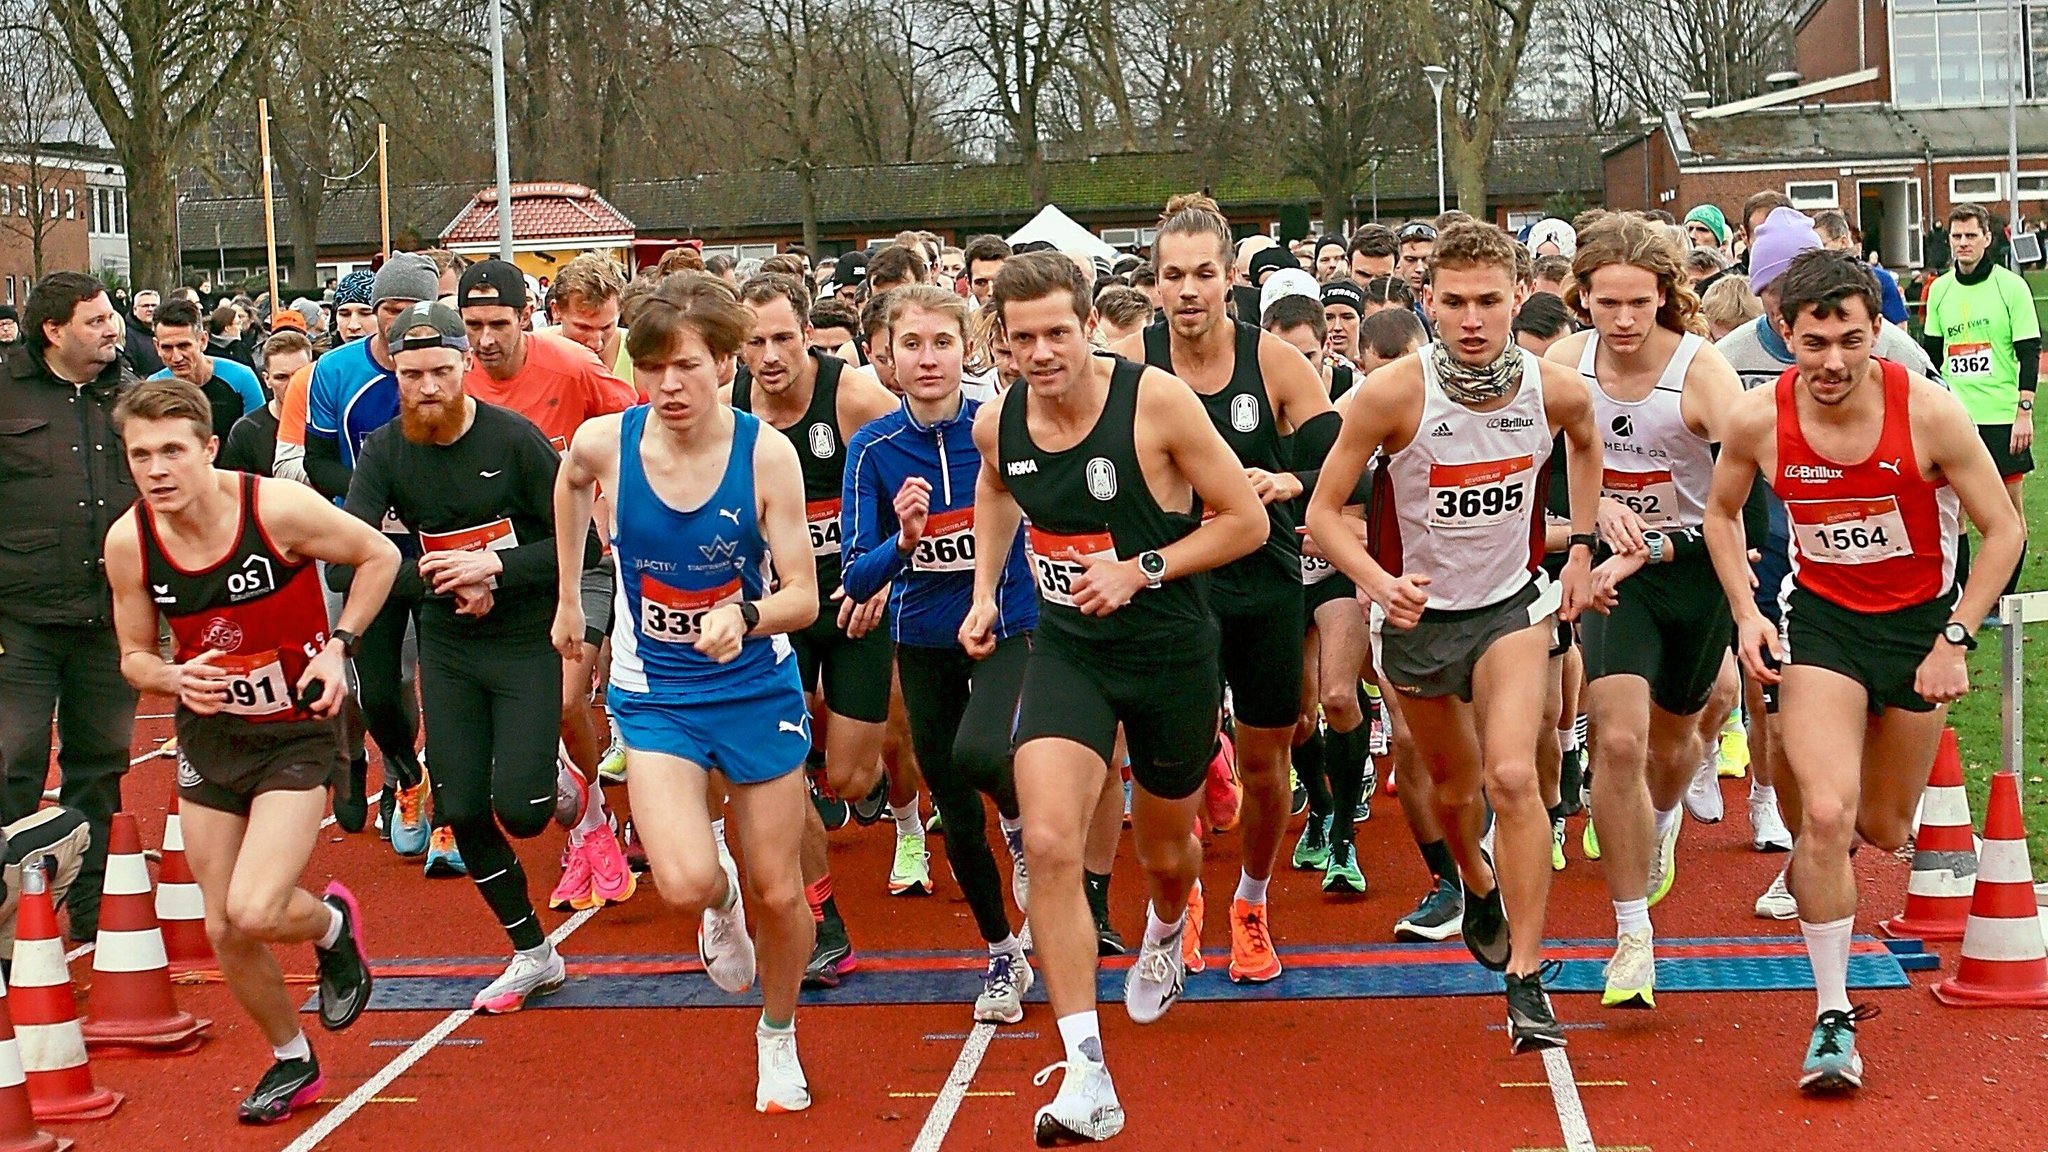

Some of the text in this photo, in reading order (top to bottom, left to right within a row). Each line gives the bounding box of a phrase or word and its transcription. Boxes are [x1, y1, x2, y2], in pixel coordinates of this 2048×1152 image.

[1950, 356, 1990, 373] 3362
[1500, 417, 1535, 429] Brillux
[1603, 441, 1645, 456] MELLE
[1007, 459, 1038, 476] HOKA
[1800, 466, 1843, 479] Brillux
[1435, 482, 1524, 518] 3695
[1814, 526, 1889, 551] 1564
[227, 569, 261, 593] OS
